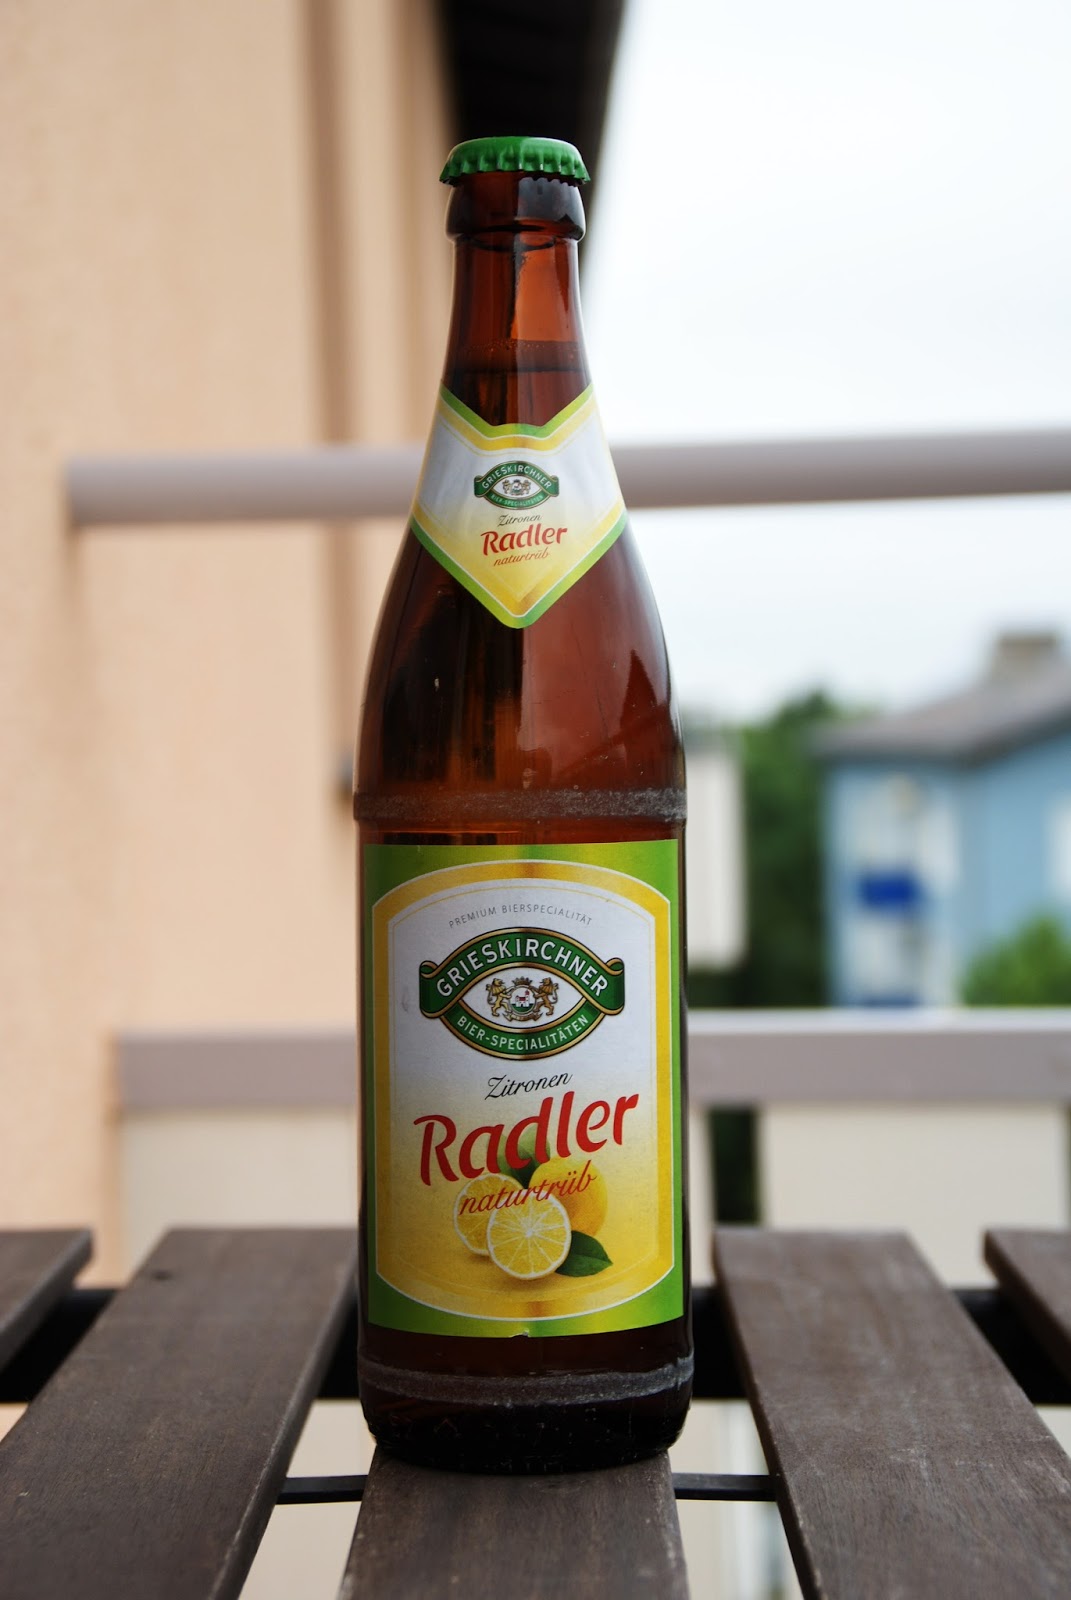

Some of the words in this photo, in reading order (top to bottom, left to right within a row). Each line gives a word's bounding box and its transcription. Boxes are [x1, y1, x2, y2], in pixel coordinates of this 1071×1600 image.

[482, 464, 552, 489] GRIESKIRCHNER
[497, 514, 542, 527] Zitronen
[480, 523, 568, 556] Radler
[493, 547, 550, 567] naturtrüb
[449, 907, 497, 928] PREMIUM
[502, 904, 592, 925] BIERSPECIALITÄT
[436, 938, 609, 998] GRIESKIRCHNER
[456, 1013, 590, 1051] BIER-SPECIALITÄTEN
[485, 1073, 573, 1100] Zitronen
[413, 1091, 639, 1186] Radler
[459, 1160, 597, 1215] naturtrüb
